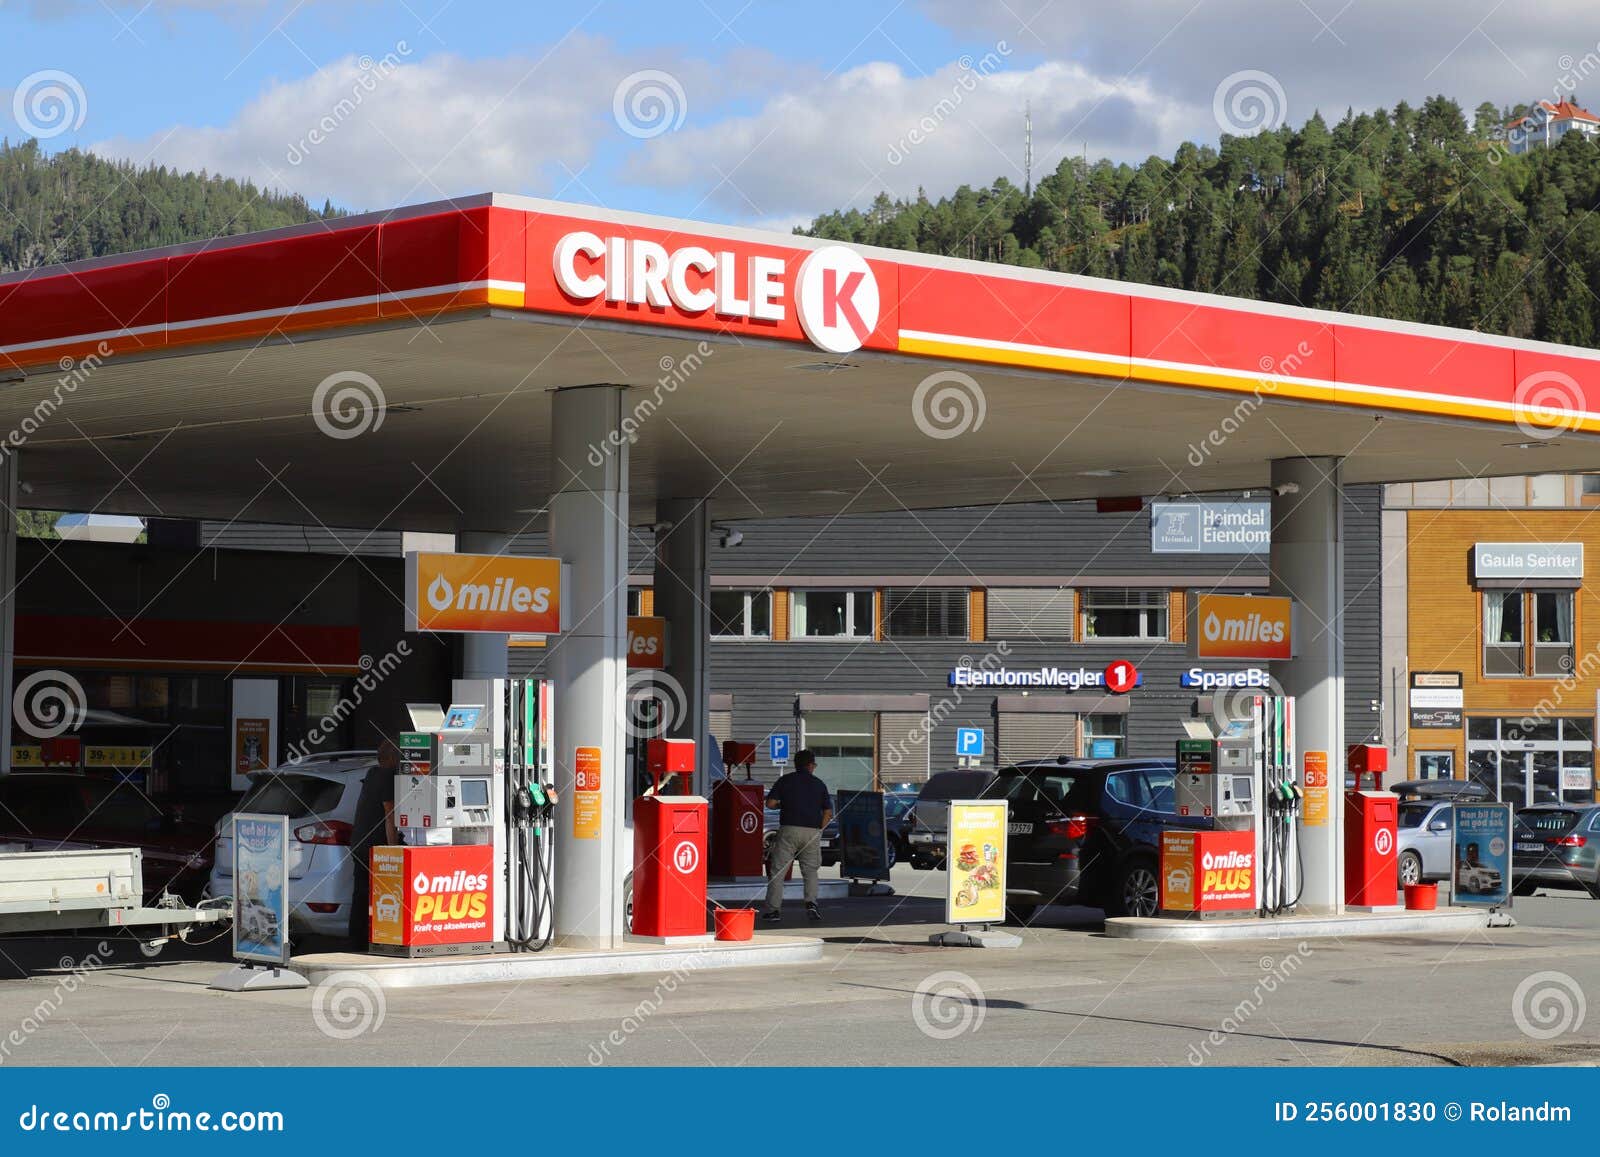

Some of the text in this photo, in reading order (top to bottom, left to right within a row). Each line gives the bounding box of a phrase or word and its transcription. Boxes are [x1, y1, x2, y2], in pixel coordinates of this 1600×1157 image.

[553, 231, 871, 346] CIRCLE K
[1203, 509, 1265, 526] Heimdal
[1203, 528, 1271, 543] Eiendom
[1480, 553, 1578, 568] Gaula Senter
[455, 577, 551, 613] miles
[1222, 613, 1285, 643] miles
[627, 630, 657, 655] les
[954, 666, 1103, 689] EiendomsMegler
[774, 736, 785, 756] P
[963, 731, 978, 752] P
[576, 771, 586, 787] 8
[1305, 771, 1315, 784] 6
[1214, 851, 1252, 869] miles
[430, 870, 488, 893] miles
[1203, 869, 1251, 892] PLUS
[414, 892, 488, 922] PLUS
[433, 924, 442, 932] og
